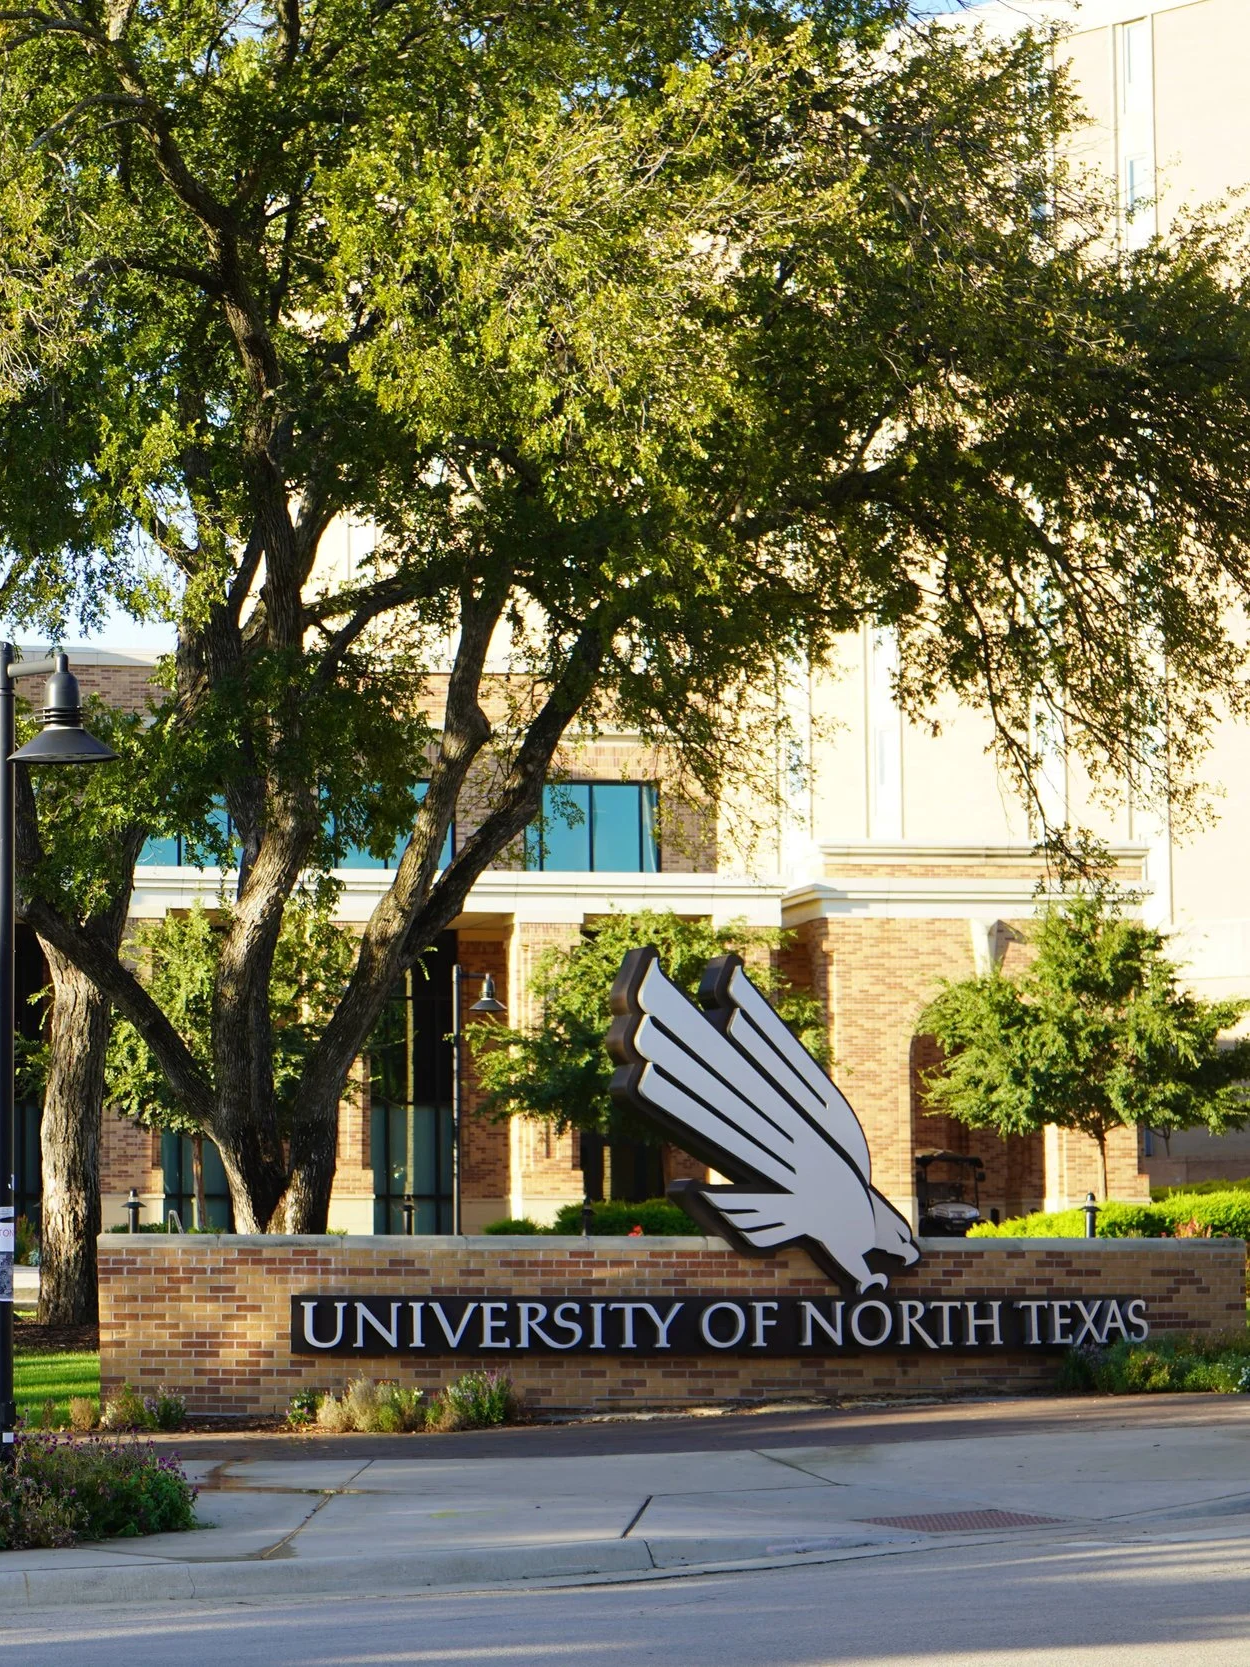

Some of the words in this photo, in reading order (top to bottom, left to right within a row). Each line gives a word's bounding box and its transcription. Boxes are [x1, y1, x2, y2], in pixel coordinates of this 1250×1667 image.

[300, 1301, 684, 1349] UNIVERSITY
[701, 1300, 779, 1349] OF
[798, 1300, 1002, 1349] NORTH
[1014, 1298, 1149, 1345] TEXAS
